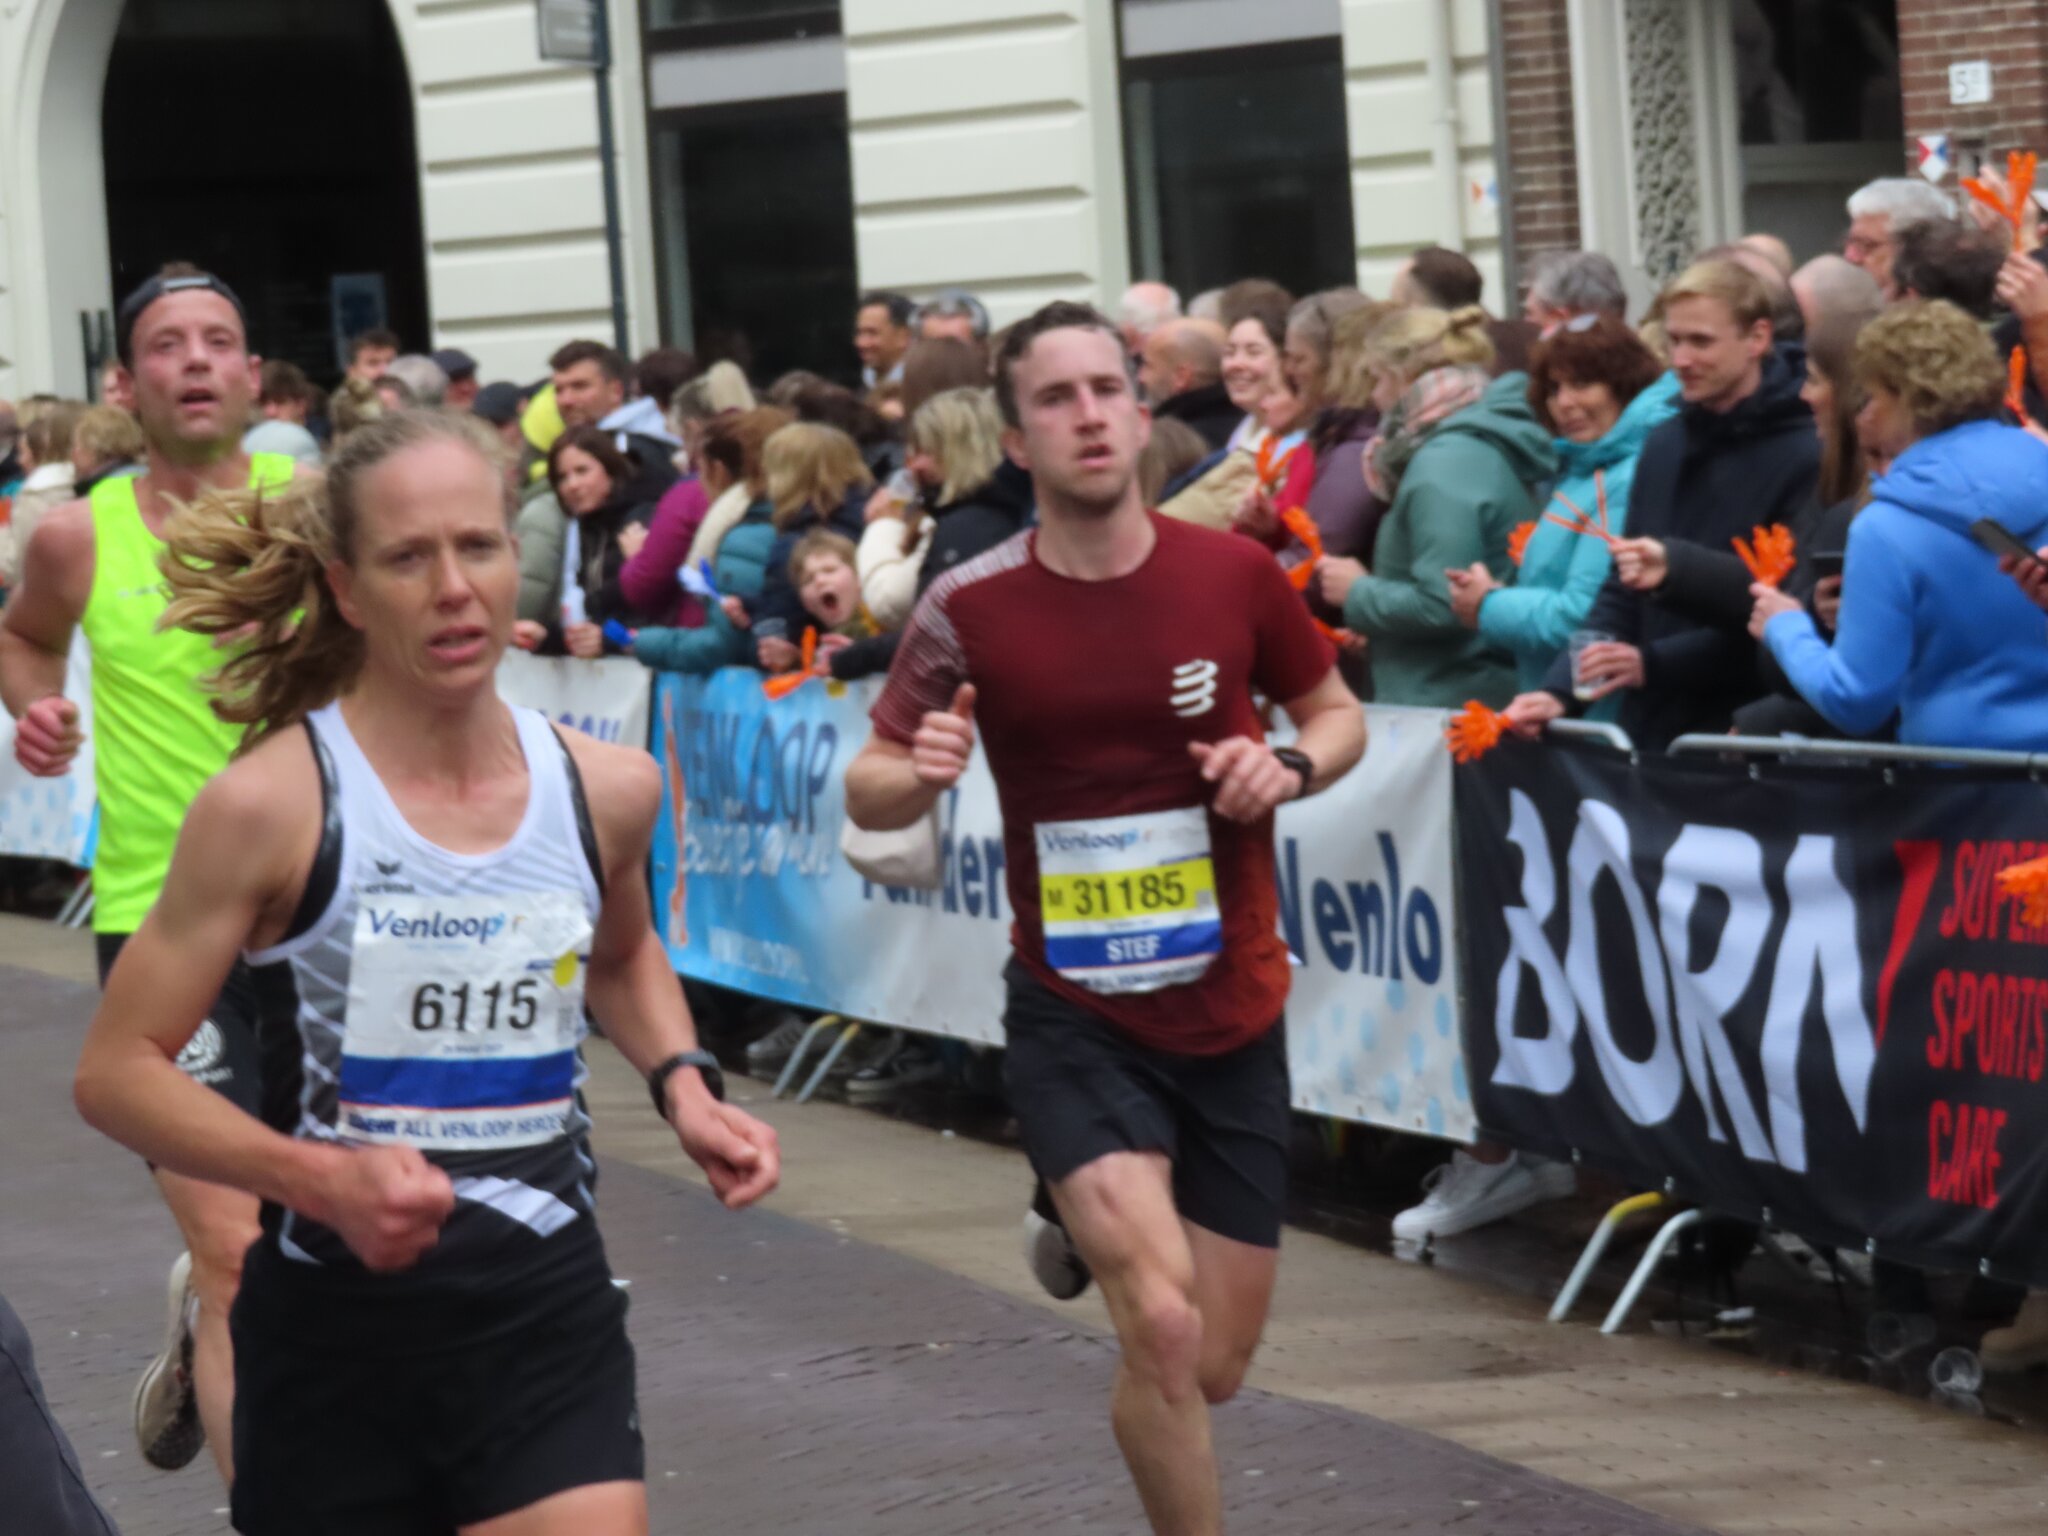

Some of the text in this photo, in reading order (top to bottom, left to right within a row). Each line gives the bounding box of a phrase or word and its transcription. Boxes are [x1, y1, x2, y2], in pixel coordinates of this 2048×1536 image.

[1044, 828, 1139, 852] Venloop
[1073, 871, 1185, 915] 31185
[1276, 830, 1442, 985] Venlo
[368, 908, 502, 944] Venloop
[1105, 934, 1161, 963] STEF
[1491, 787, 1940, 1173] BORN
[411, 978, 537, 1032] 6115
[1927, 969, 2048, 1082] SPORTS
[403, 1119, 433, 1137] ALL
[440, 1118, 513, 1138] VENLOOP
[1929, 1100, 2009, 1210] CARE
